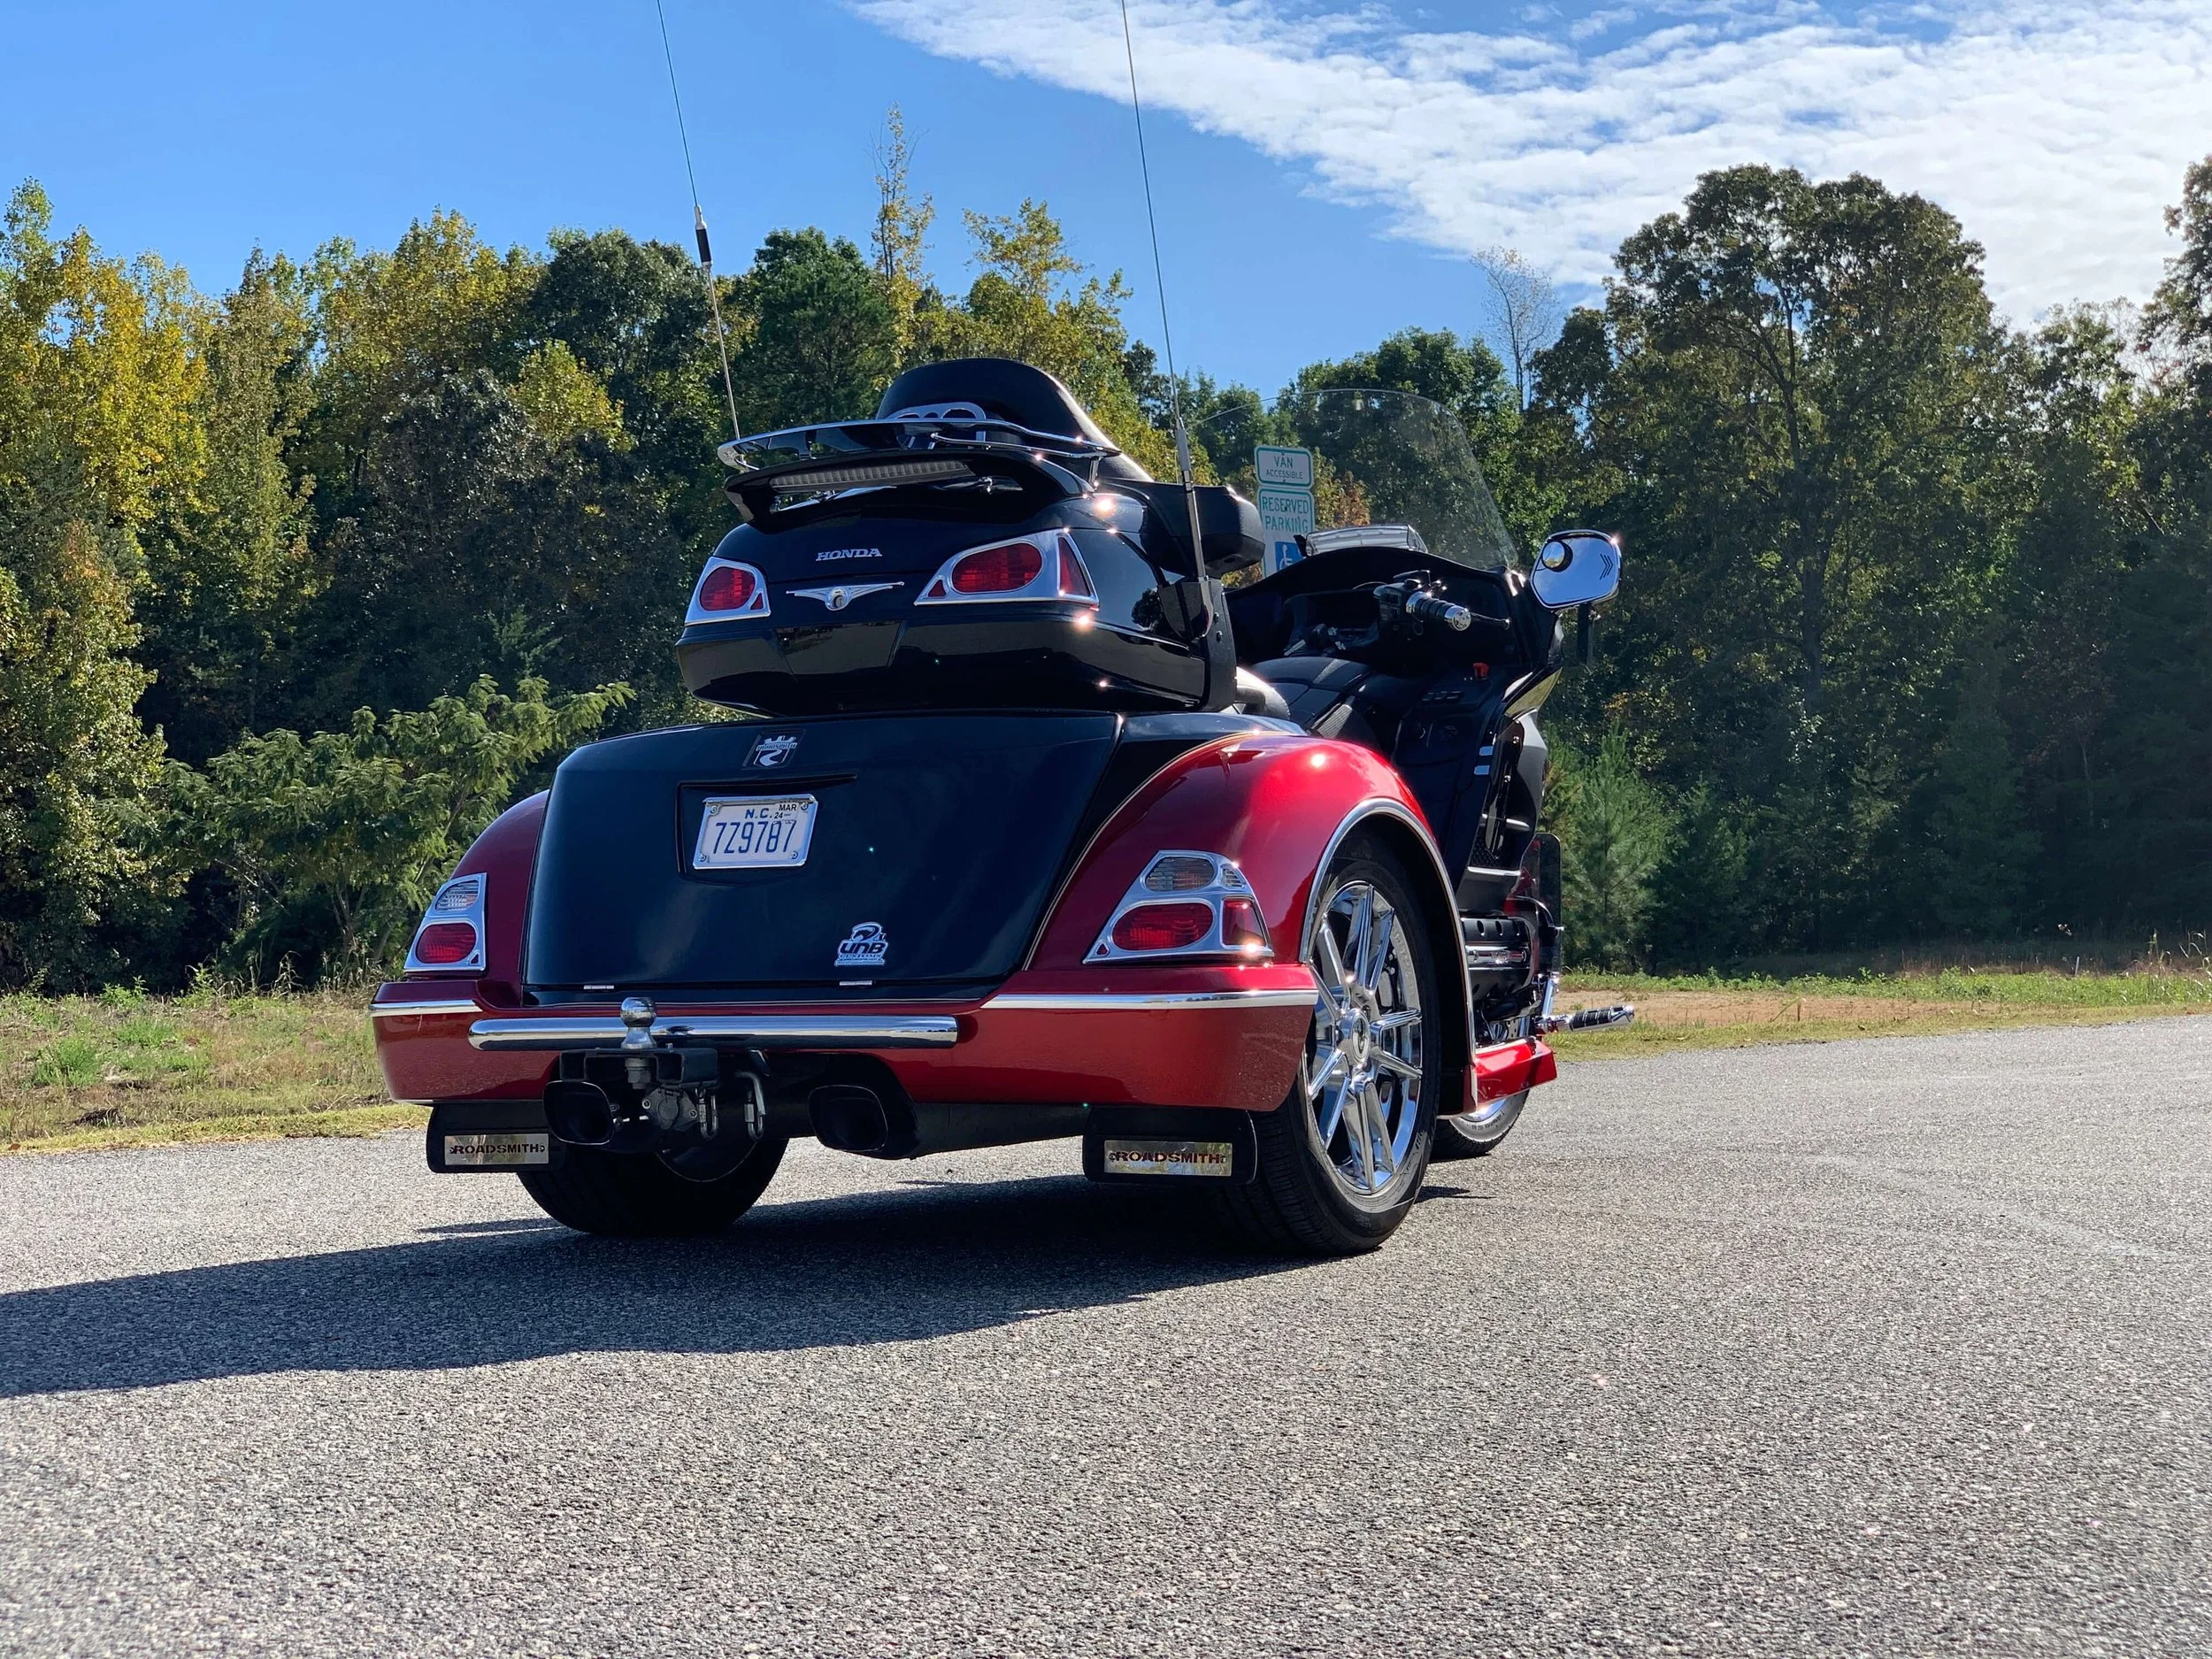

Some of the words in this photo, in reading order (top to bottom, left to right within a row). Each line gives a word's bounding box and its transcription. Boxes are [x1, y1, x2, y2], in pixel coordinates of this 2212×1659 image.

[1274, 456, 1294, 468] VAN
[1265, 469, 1303, 480] ACCESSIBLE
[1262, 496, 1309, 514] RESERVED
[1264, 515, 1309, 533] PARKING
[815, 548, 883, 562] HONDA
[744, 808, 772, 819] N.C.
[452, 1143, 539, 1155] ROADSMITH
[1115, 1151, 1221, 1164] ROADSMITH
